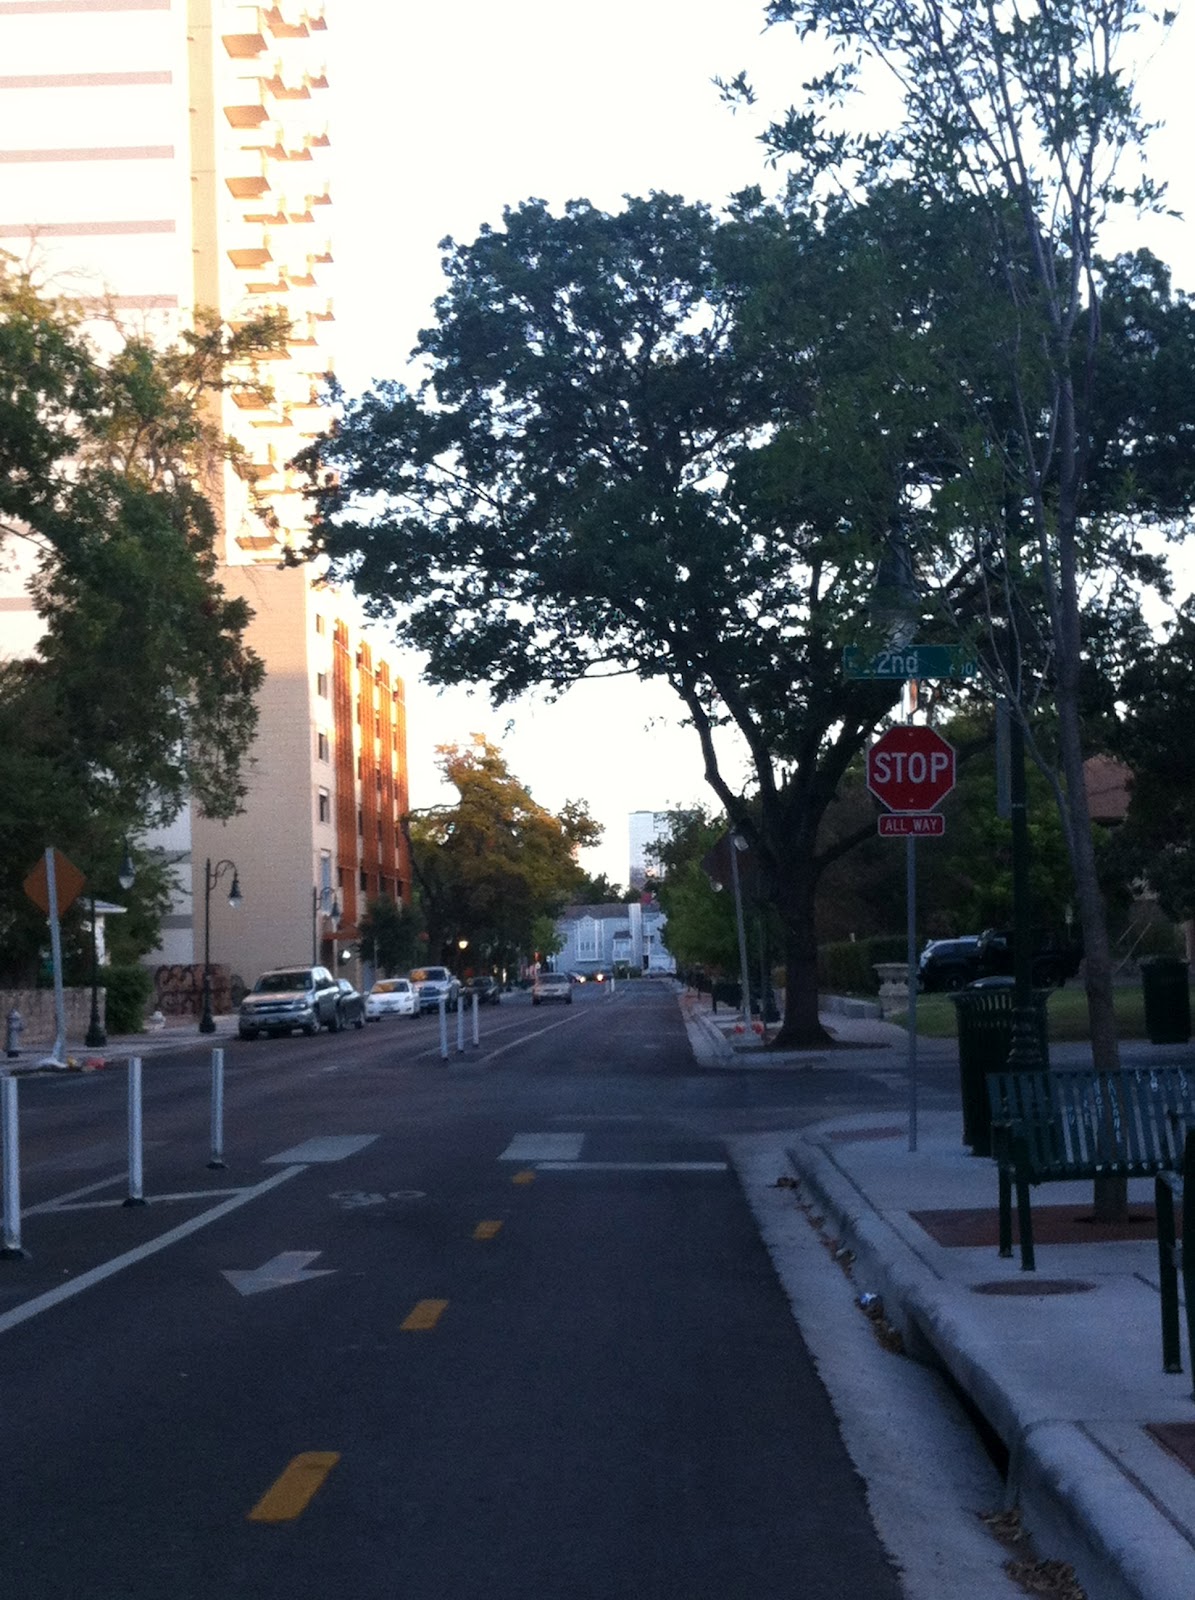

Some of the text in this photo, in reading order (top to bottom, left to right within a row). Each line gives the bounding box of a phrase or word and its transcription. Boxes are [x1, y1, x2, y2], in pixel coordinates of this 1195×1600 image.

[877, 651, 919, 674] 2nd
[873, 752, 949, 783] STOP
[885, 818, 938, 832] ALL WAY
